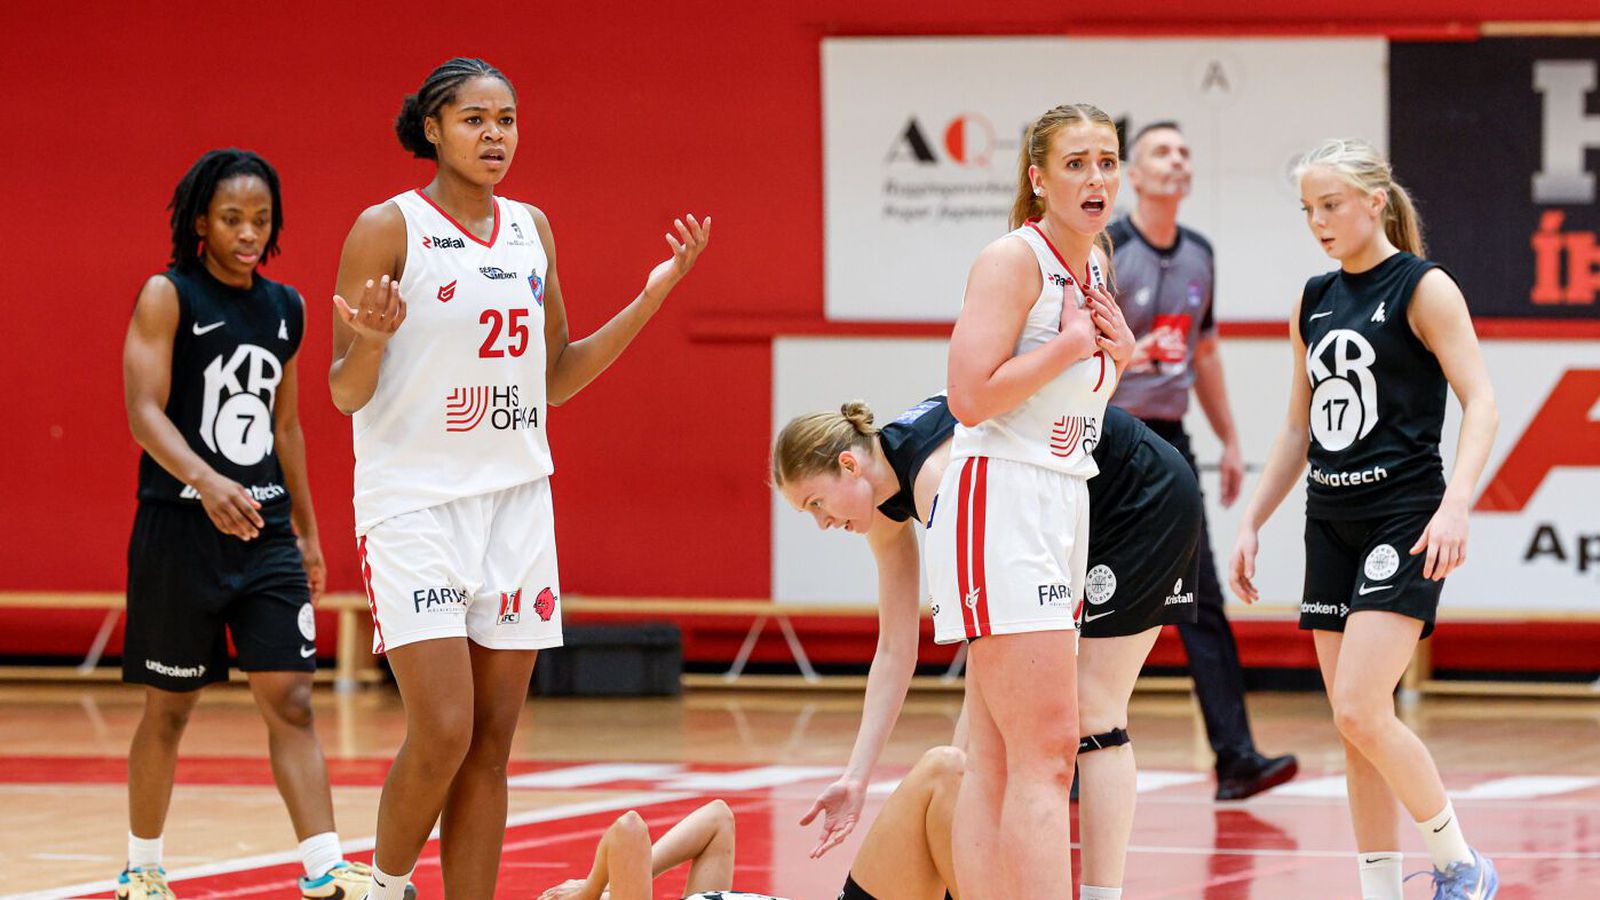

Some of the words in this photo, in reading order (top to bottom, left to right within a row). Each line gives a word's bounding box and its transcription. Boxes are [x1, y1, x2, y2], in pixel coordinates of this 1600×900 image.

[478, 308, 529, 358] 25
[199, 343, 284, 456] KR
[492, 384, 519, 408] HS
[1306, 328, 1379, 441] KR
[236, 414, 255, 444] 7
[1322, 398, 1349, 431] 17
